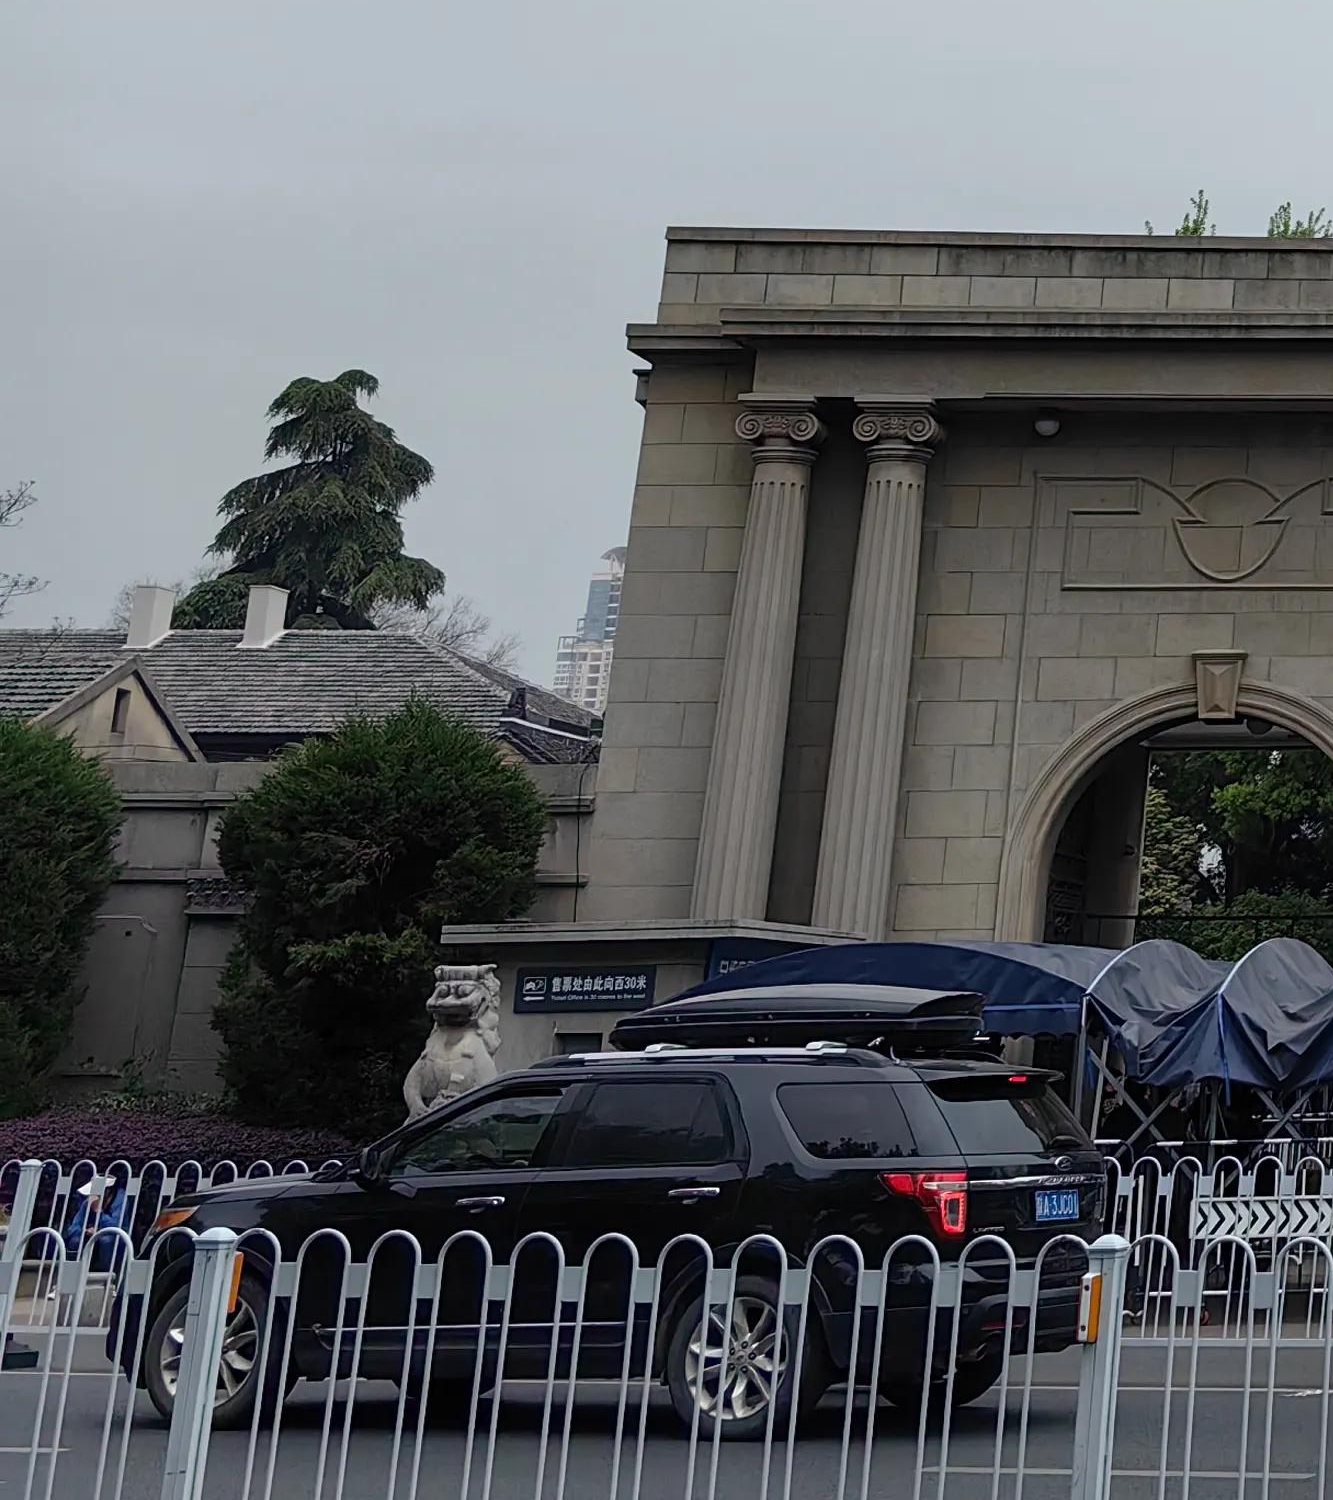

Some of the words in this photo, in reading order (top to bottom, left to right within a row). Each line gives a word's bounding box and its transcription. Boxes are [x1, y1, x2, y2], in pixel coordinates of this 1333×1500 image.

[551, 975, 647, 992] 售票处由此向西30米
